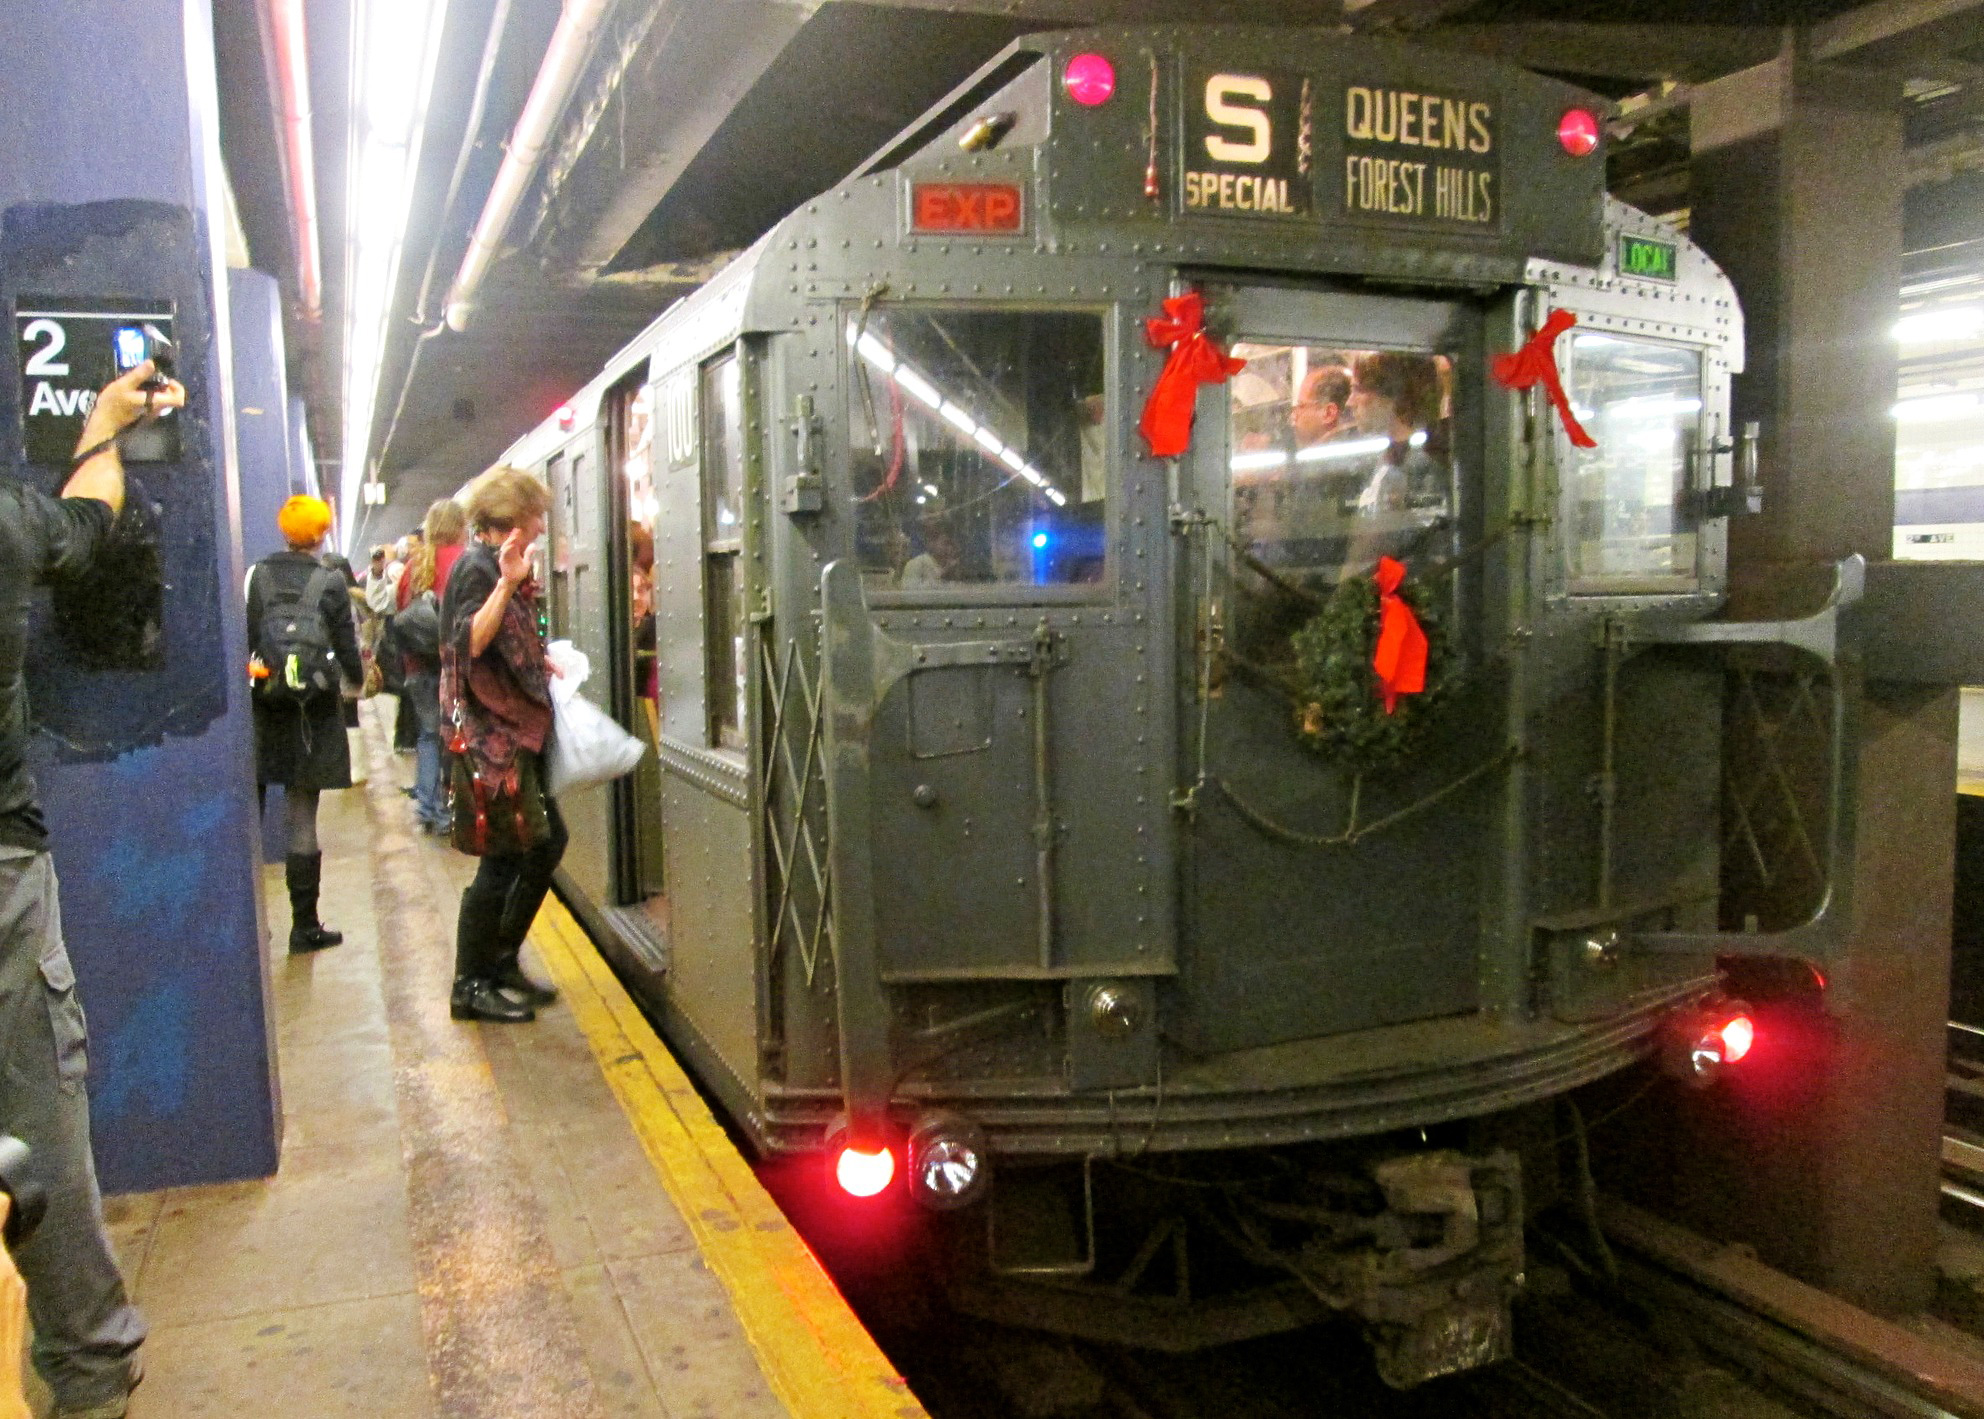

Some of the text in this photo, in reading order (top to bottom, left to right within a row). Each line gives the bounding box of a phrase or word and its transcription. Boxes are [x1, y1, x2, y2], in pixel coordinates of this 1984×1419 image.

[1205, 73, 1272, 163] S
[1347, 86, 1491, 153] QUEENS
[920, 190, 1015, 228] EXP
[1186, 171, 1294, 213] SPECIAL
[1347, 156, 1491, 222] FOREST HILLS
[23, 319, 69, 376] 2
